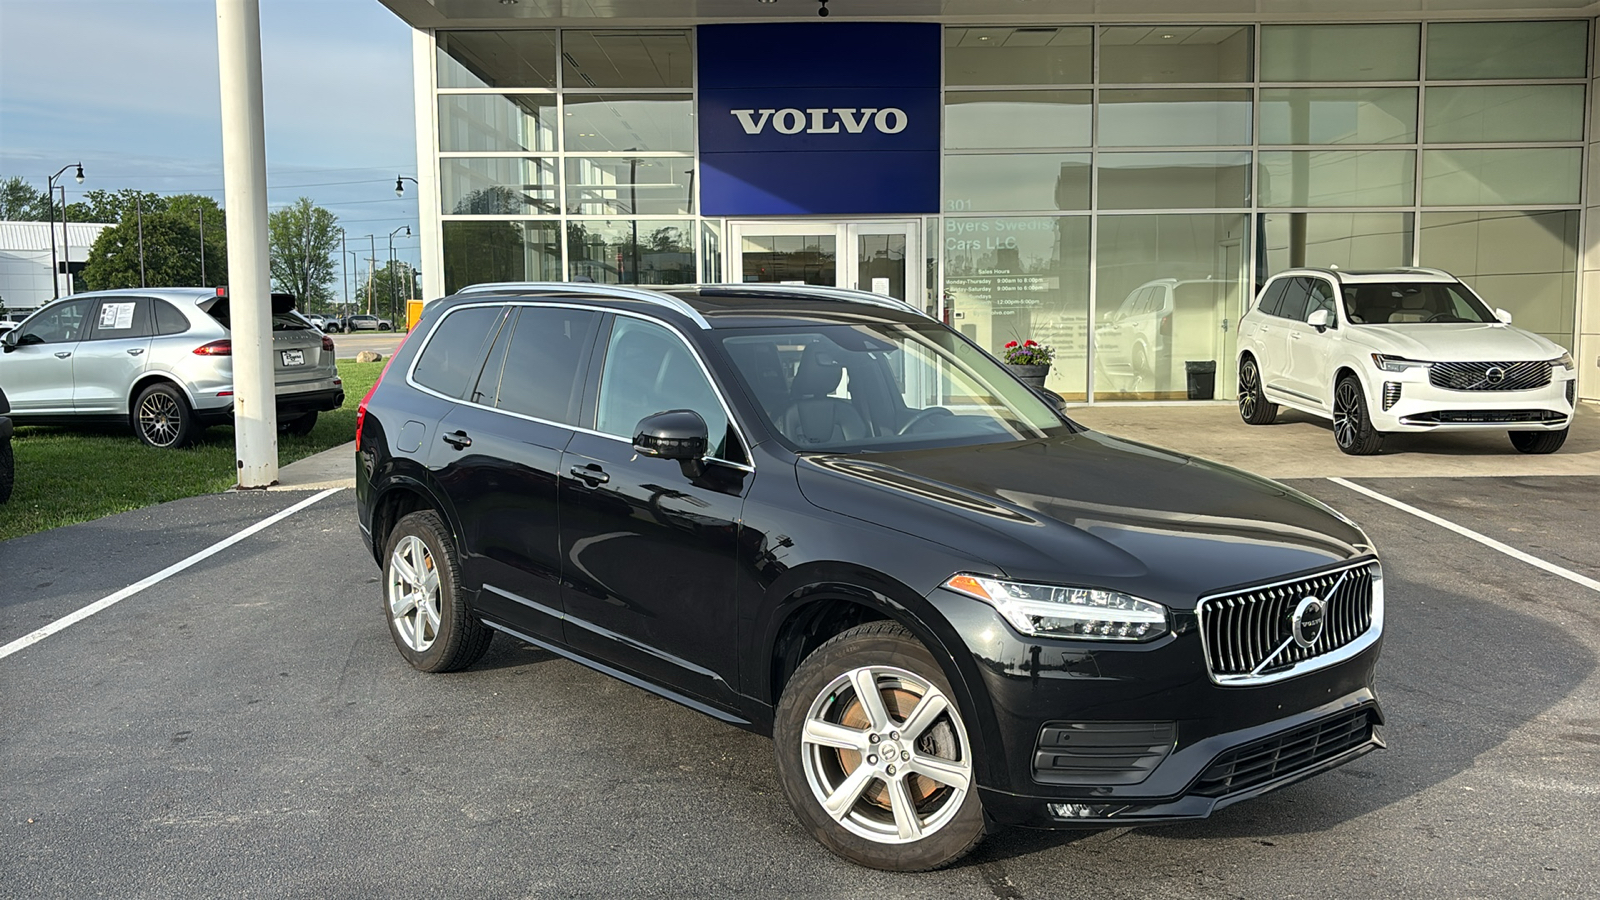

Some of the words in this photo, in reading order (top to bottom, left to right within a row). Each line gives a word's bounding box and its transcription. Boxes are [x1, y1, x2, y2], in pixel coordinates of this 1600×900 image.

[730, 107, 908, 135] VOLVO
[946, 199, 971, 211] 301
[946, 219, 989, 236] Byers
[946, 237, 981, 250] Cars
[986, 236, 1017, 250] LLC
[1301, 617, 1322, 628] VOLVO
